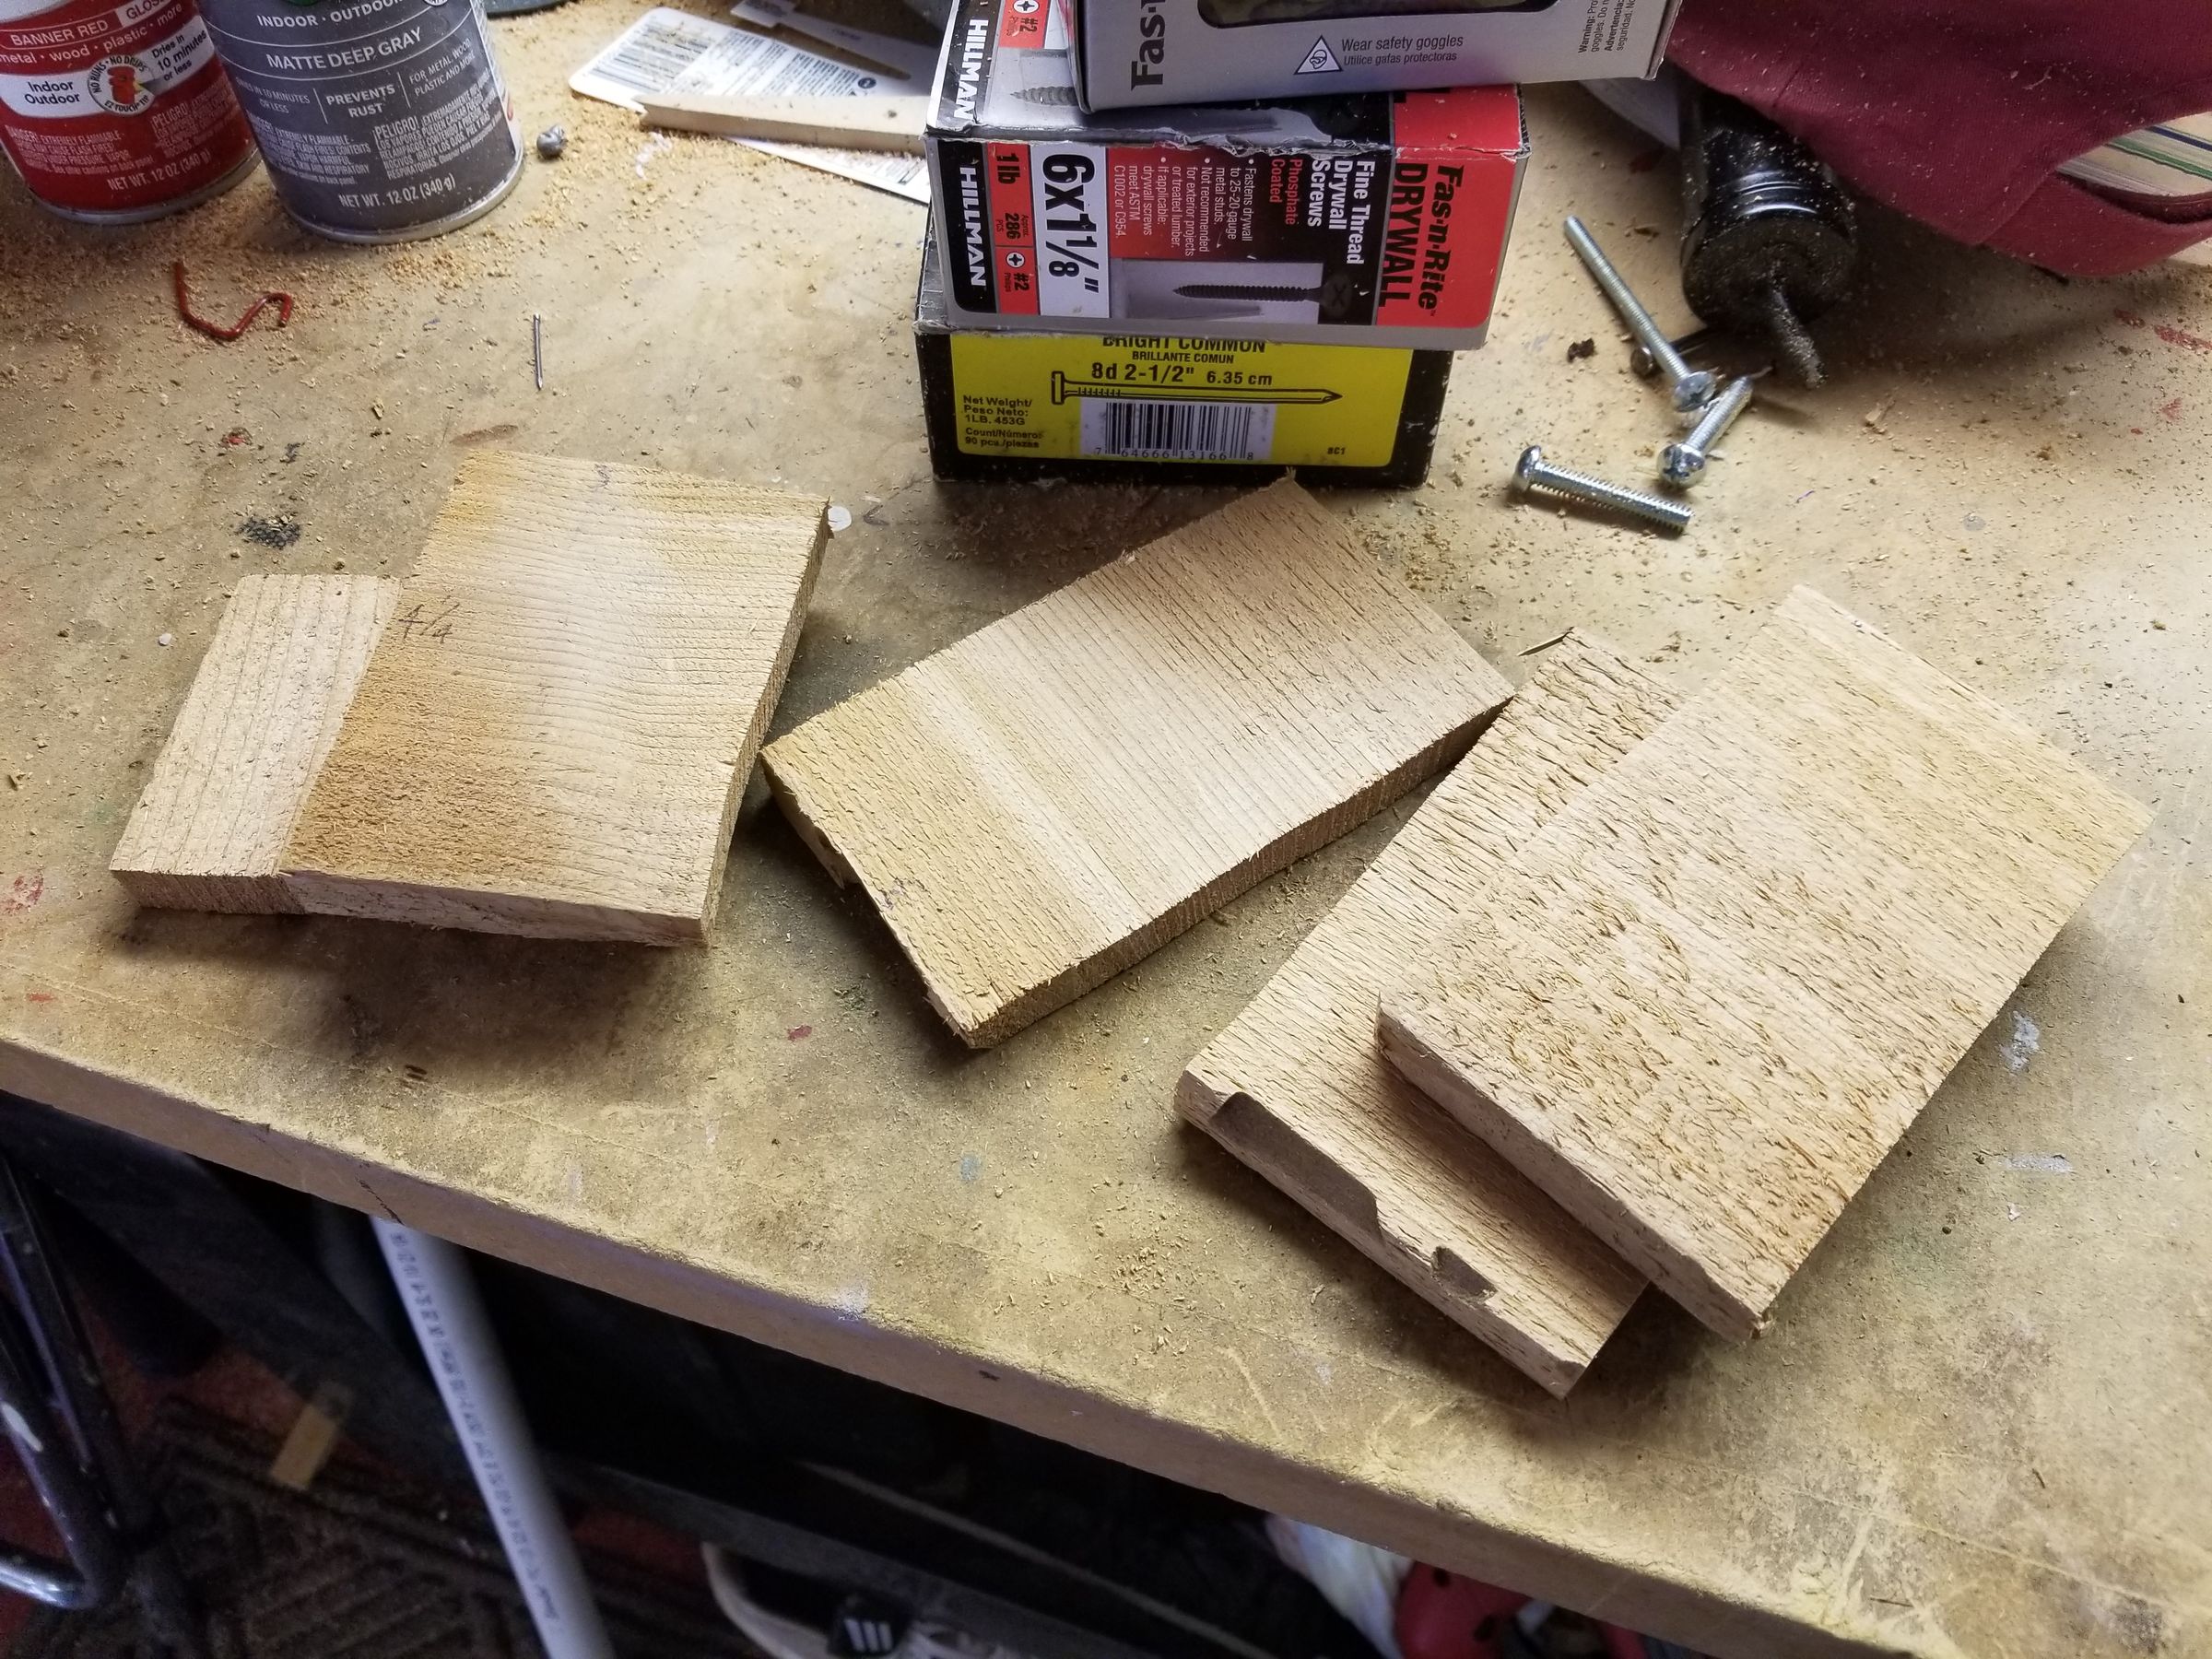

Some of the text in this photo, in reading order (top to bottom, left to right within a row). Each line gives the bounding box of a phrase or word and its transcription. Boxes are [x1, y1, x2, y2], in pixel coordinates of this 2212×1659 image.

[10, 20, 109, 46] BANNER RED
[49, 44, 90, 62] wood
[103, 26, 147, 53] plastic
[157, 4, 183, 27] more
[257, 15, 318, 28] INDOOR
[1019, 18, 1038, 31] #2
[1578, 16, 1595, 53] Warning:
[1617, 11, 1633, 51] seguridad.
[152, 34, 185, 58] Dries in
[158, 29, 207, 71] 10 minutes
[265, 26, 420, 71] MATTE DEEP GRAY
[1342, 34, 1464, 52] Wear safety goggles
[1591, 20, 1605, 53] goggles.
[163, 59, 192, 81] or less
[954, 19, 989, 121] HILLMAN
[1344, 52, 1457, 65] Utilice gafas protectoras
[28, 80, 74, 93] Indoor
[90, 55, 147, 93] NO RUNS NO DRIPS
[409, 70, 427, 85] FOR
[414, 74, 445, 96] PLASTIC
[445, 65, 461, 80] AND
[24, 92, 81, 106] Outdoor
[272, 90, 311, 103] MINUTES
[325, 85, 395, 106] PREVENTS
[348, 102, 383, 118] RUST
[377, 138, 391, 152] LOS
[391, 130, 422, 150] VAPORES
[107, 177, 128, 191] NET
[129, 172, 150, 187] WT.
[151, 168, 165, 182] 12
[166, 162, 180, 177] OZ
[1230, 167, 1241, 177] to
[1269, 158, 1286, 203] Coated
[338, 194, 359, 208] NET
[360, 193, 384, 207] WT.
[385, 189, 402, 205] 12
[401, 186, 419, 201] OZ
[1114, 165, 1126, 238] C1002 or C954.
[1129, 166, 1140, 220] meet ASTM
[1141, 166, 1155, 236] drywall screws
[1155, 175, 1169, 225] applicable:
[1213, 167, 1226, 225] metal studs.
[1241, 168, 1257, 241] Fastens drywall
[1285, 159, 1303, 225] Phosphate
[1307, 159, 1331, 228] Screws
[1328, 160, 1353, 229] Drywall
[1171, 167, 1182, 248] or treated lumber.
[1182, 167, 1197, 256] for exterior projects
[1199, 167, 1212, 253] Not recommended
[1347, 160, 1375, 265] Fine Thread
[959, 167, 986, 287] HILLMAN
[1005, 213, 1021, 240] 286
[1379, 162, 1429, 308] DRYWALL
[1014, 273, 1030, 291] #2
[1132, 351, 1234, 364] BRILLANTE COMUN
[1091, 362, 1273, 385] 8d 2-1/2" 6.35 cm
[963, 394, 983, 405] Net
[964, 404, 1029, 417] Peso Neto:
[965, 414, 1026, 425] 1LB. 453G
[965, 436, 977, 444] 90
[1121, 449, 1170, 458] 64666
[1179, 449, 1227, 461] 13166
[1246, 452, 1254, 461] 8
